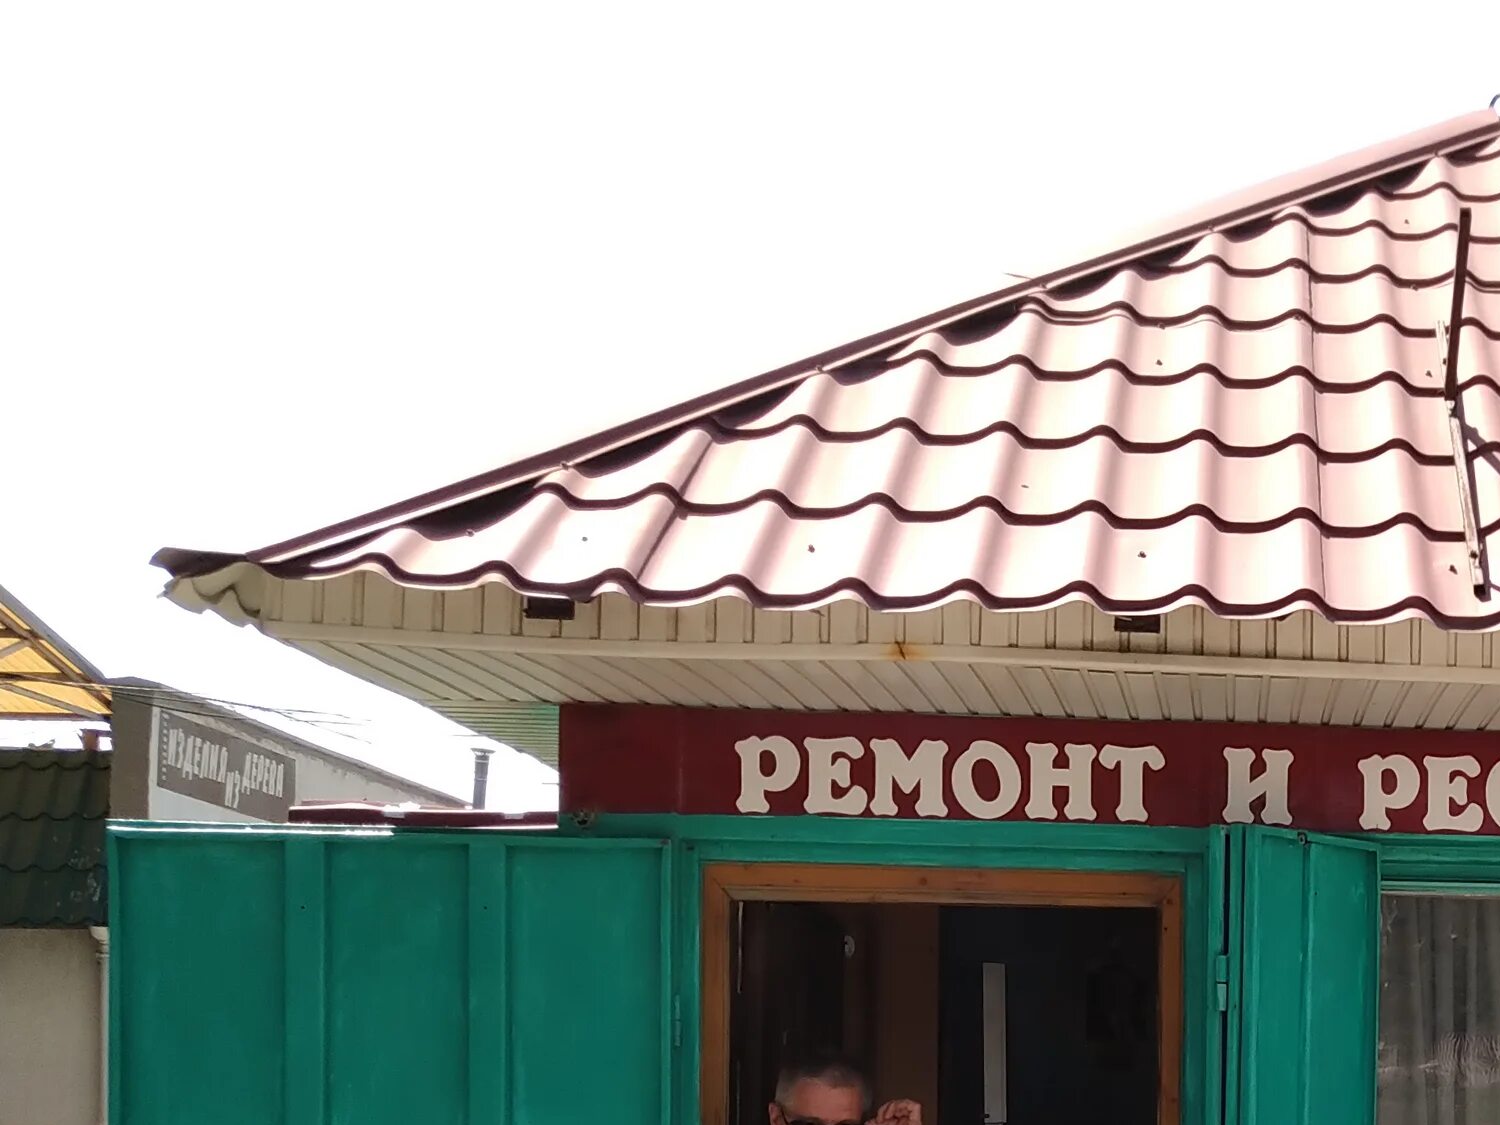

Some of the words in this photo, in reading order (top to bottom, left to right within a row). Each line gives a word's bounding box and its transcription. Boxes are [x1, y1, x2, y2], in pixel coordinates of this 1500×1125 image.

[167, 728, 229, 784] ИЗДЕЛИЯ
[241, 752, 284, 798] ДЕРЕВА
[734, 735, 1166, 823] РЕМОНТ
[1221, 746, 1296, 825] И
[224, 771, 241, 809] ИЗ
